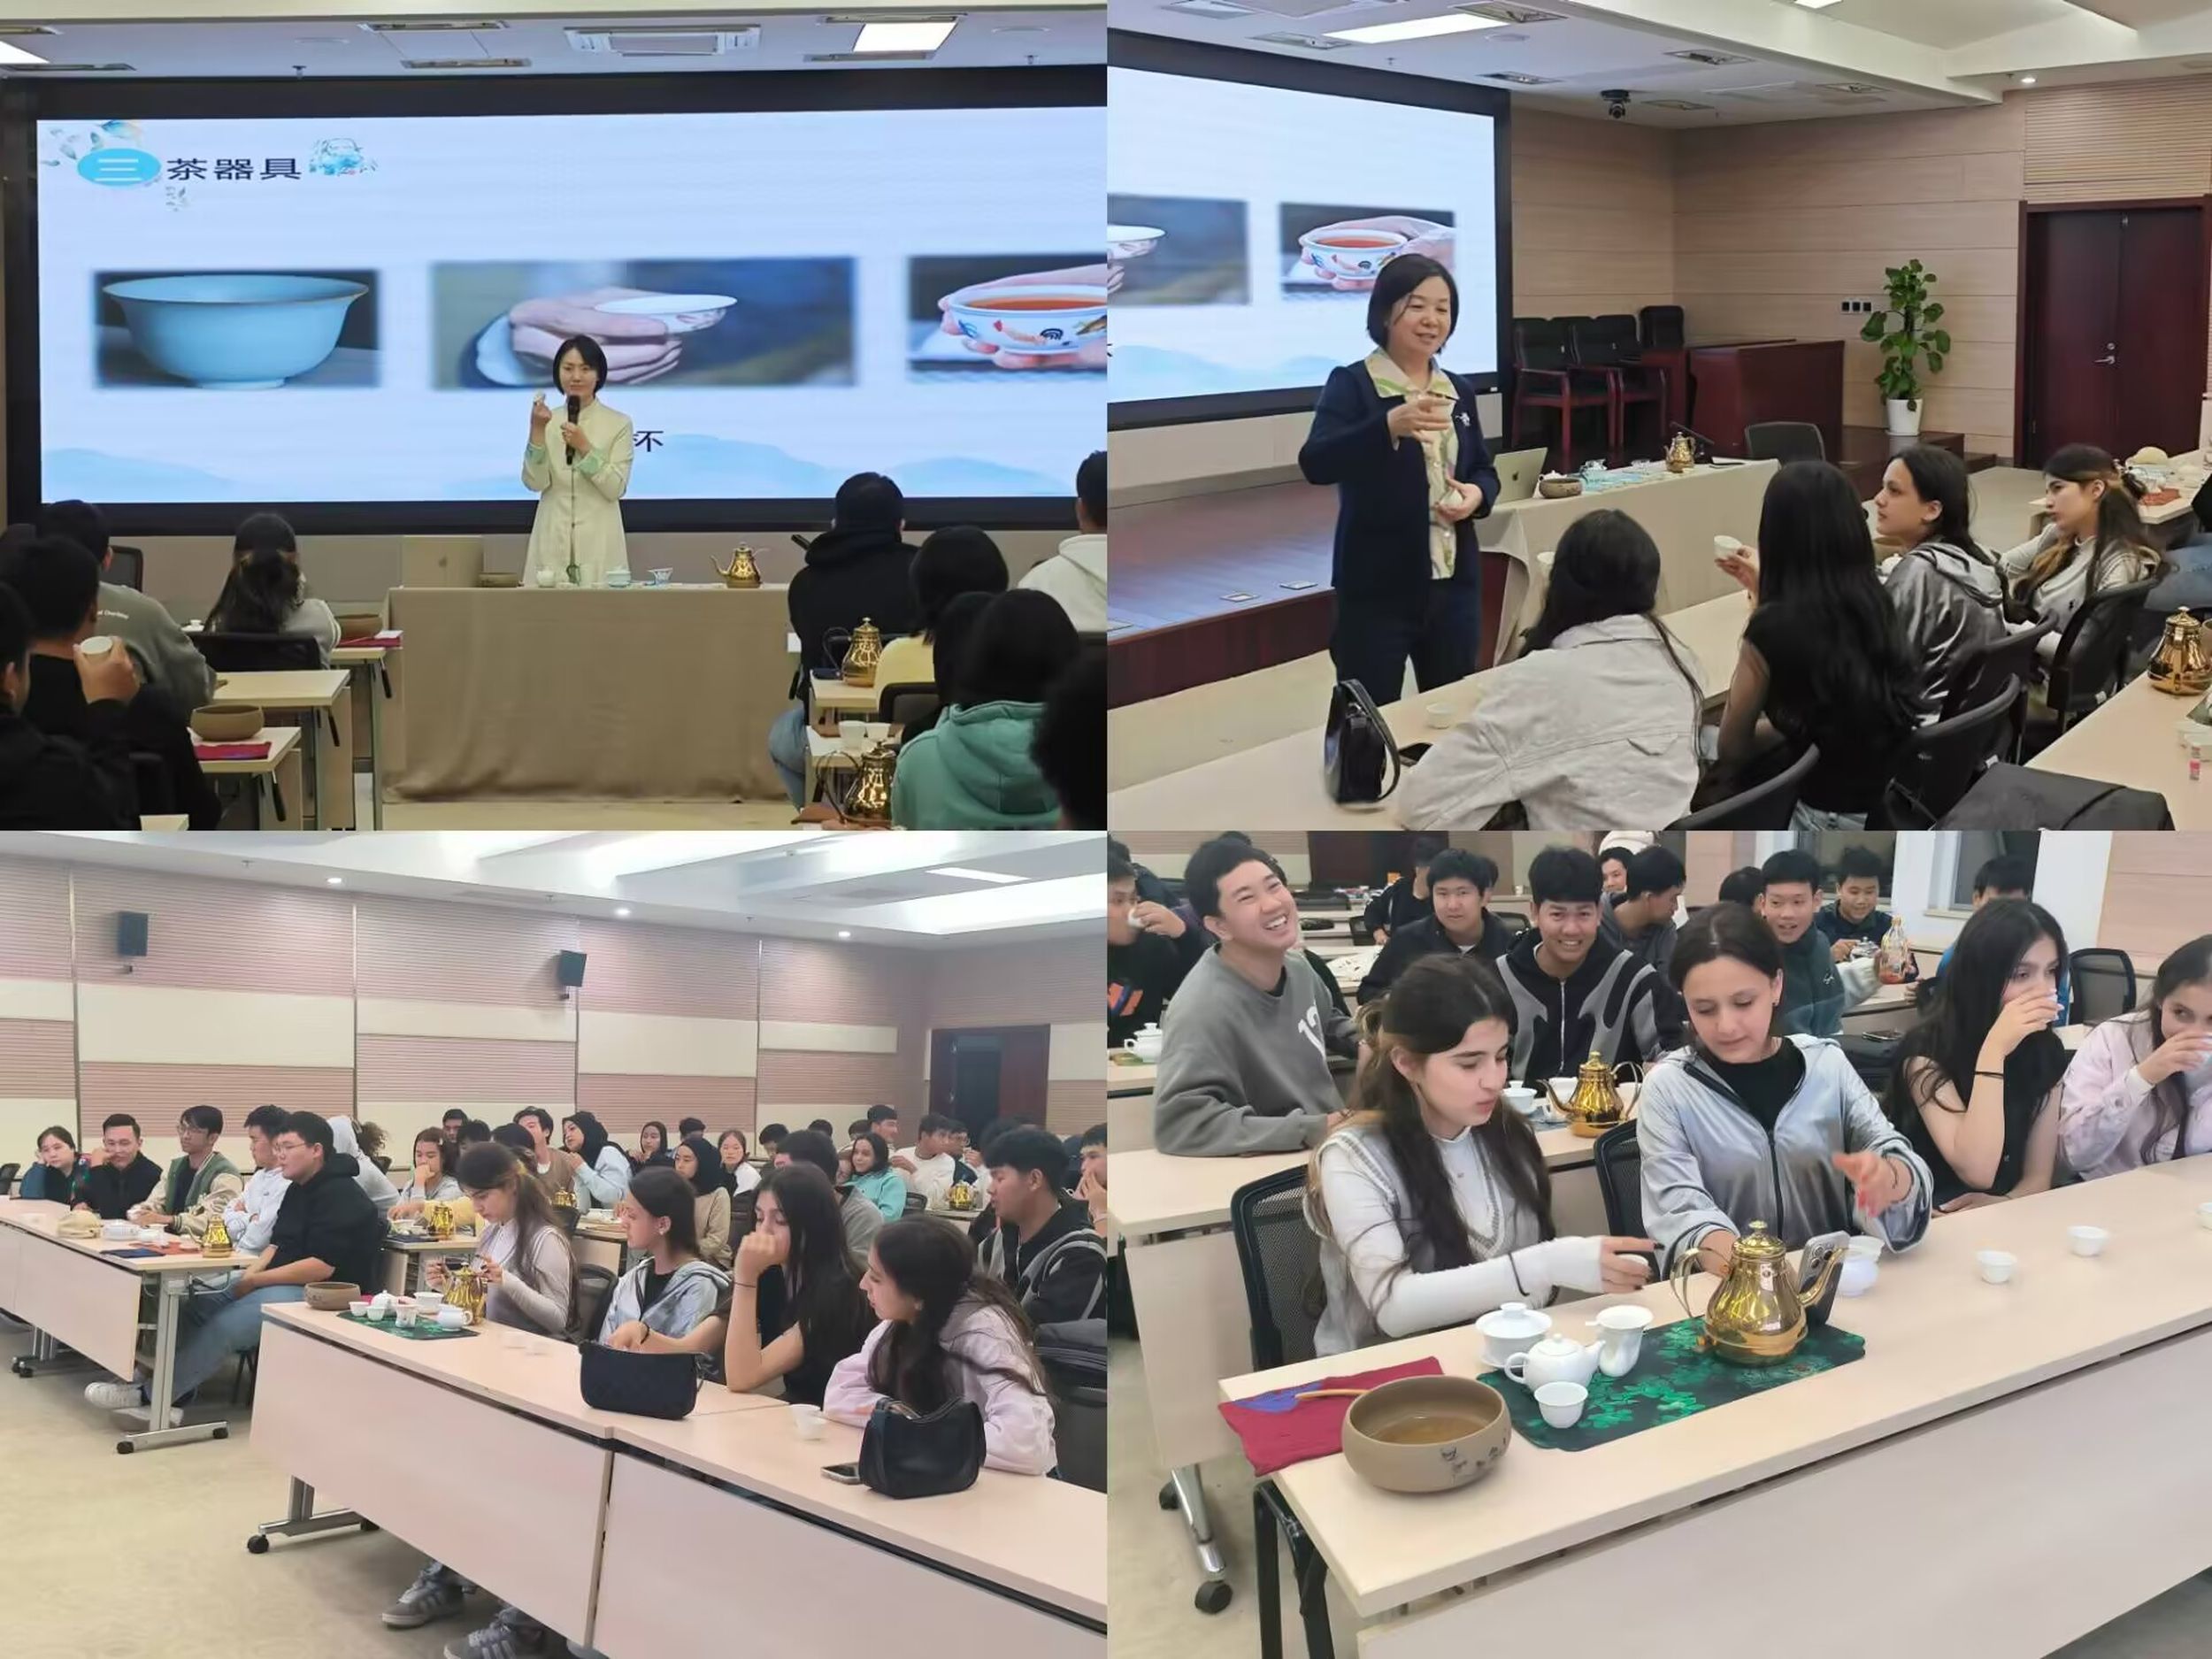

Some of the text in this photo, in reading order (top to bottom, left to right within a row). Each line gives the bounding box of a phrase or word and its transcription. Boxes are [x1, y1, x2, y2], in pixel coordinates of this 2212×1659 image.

[95, 157, 302, 181] 三 茶器具
[633, 430, 664, 452] 不
